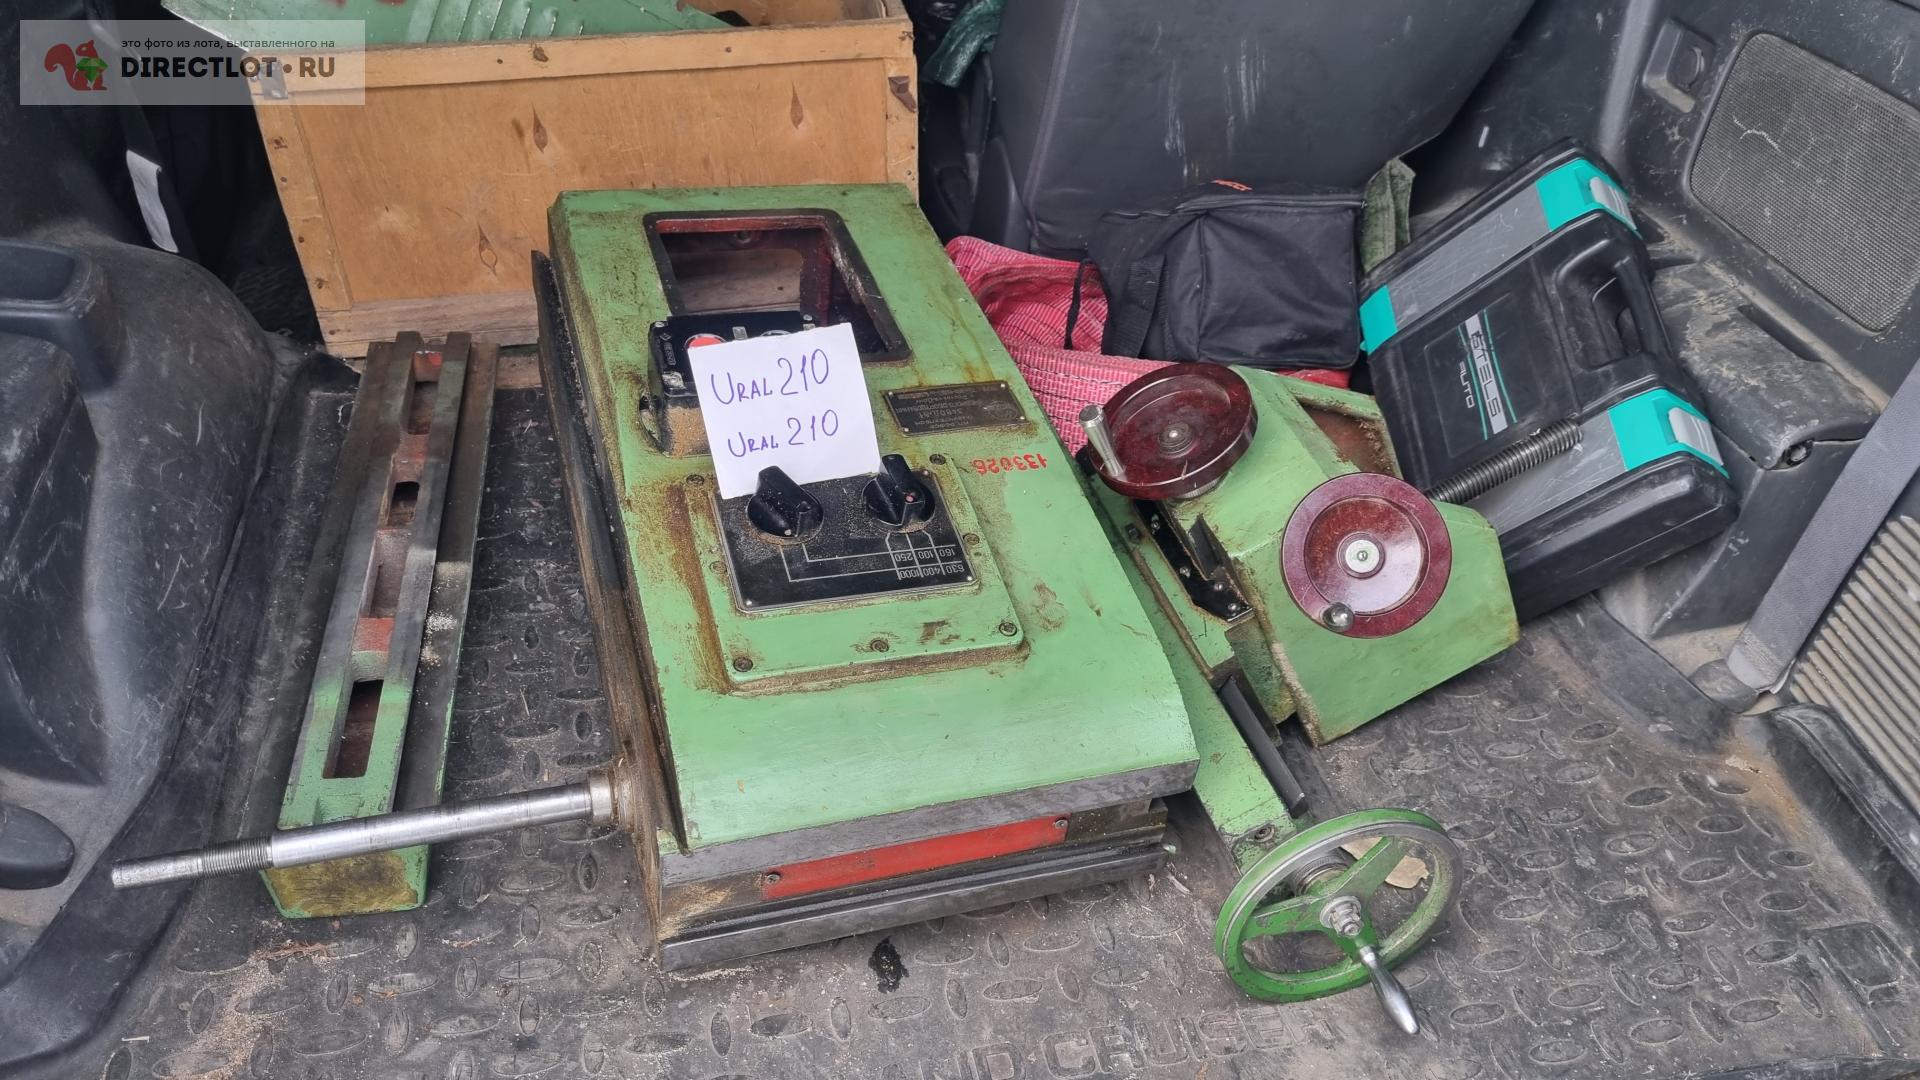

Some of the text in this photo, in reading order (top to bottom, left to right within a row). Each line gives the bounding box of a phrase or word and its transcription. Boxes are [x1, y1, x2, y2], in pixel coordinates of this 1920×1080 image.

[777, 348, 829, 396] 210
[1459, 361, 1475, 409] AUTO
[1471, 329, 1501, 417] STELS
[787, 409, 839, 446] 210
[894, 548, 956, 562] 160 100 250
[899, 563, 965, 579] 630 400 1000
